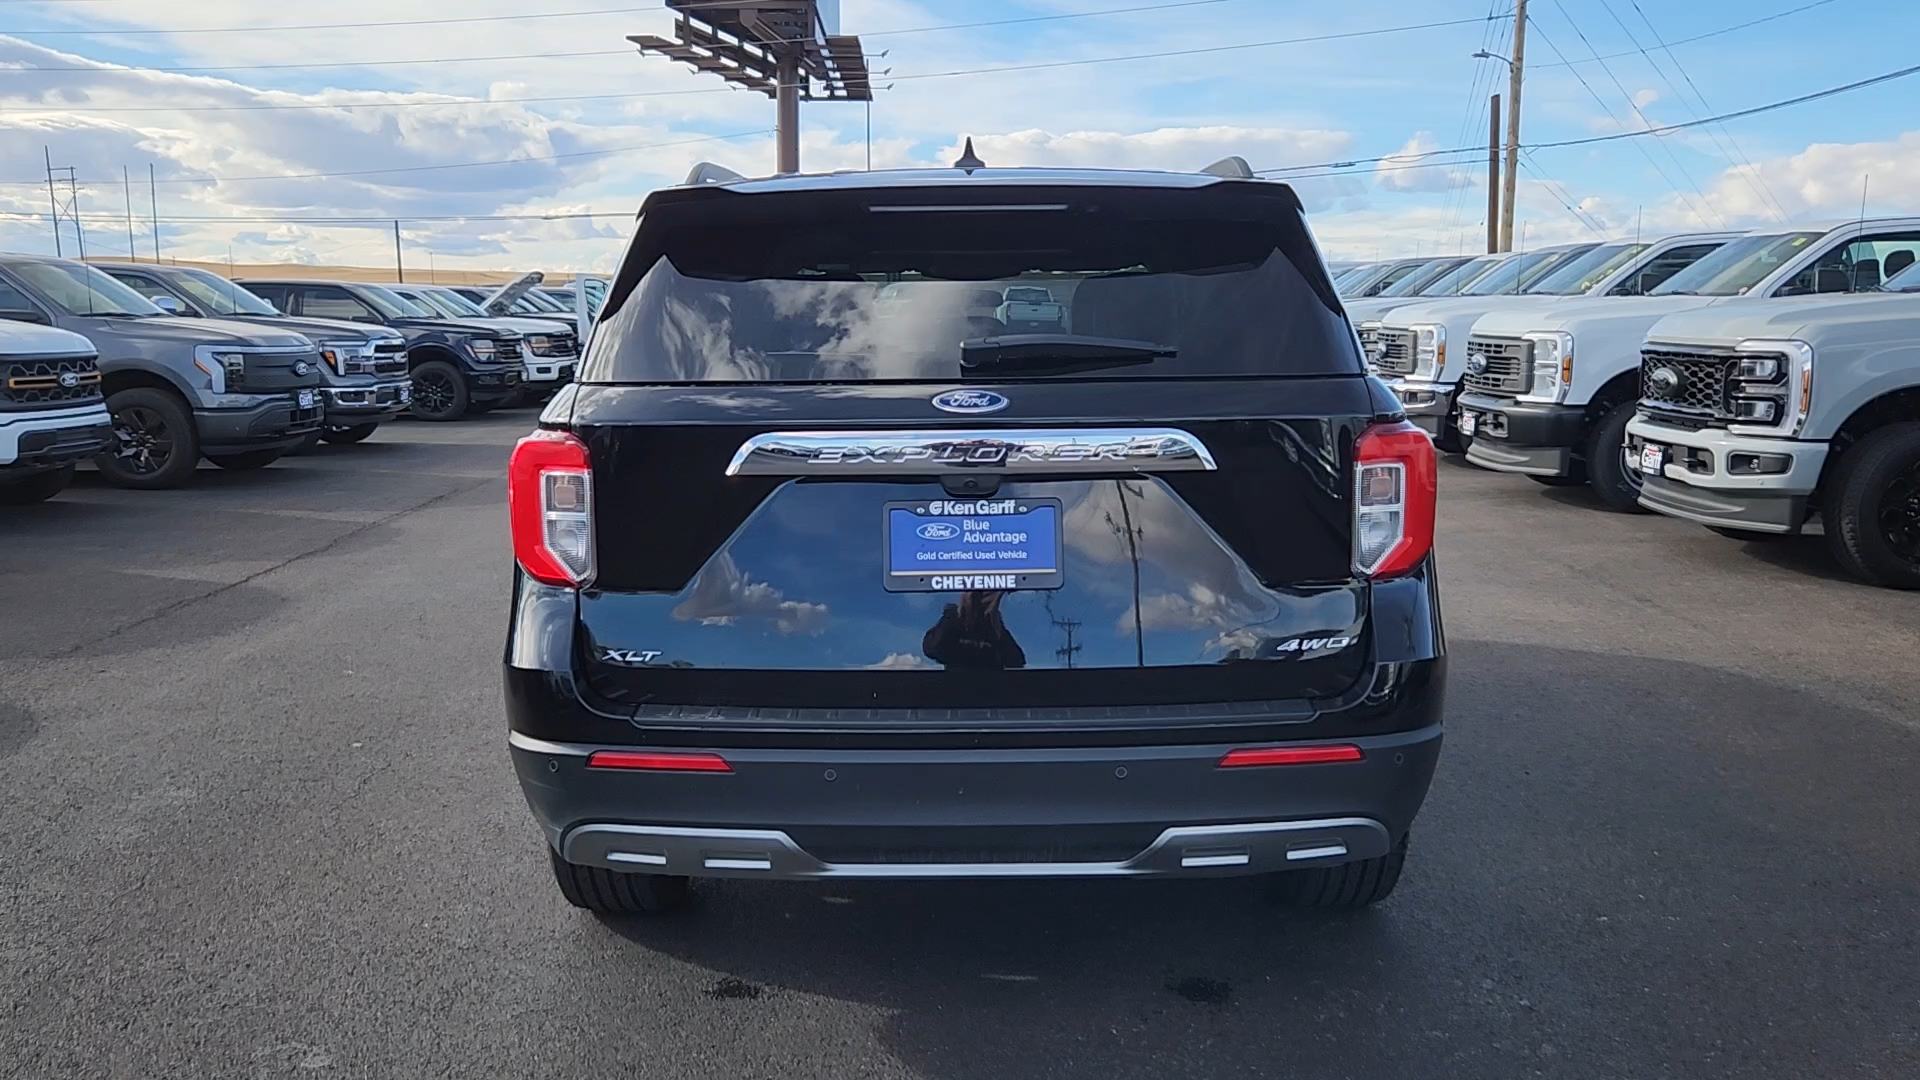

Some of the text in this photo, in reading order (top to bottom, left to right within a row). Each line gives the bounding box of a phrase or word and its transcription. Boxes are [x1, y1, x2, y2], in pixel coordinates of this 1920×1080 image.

[949, 392, 990, 407] Ford
[807, 445, 1128, 464] EXPLORER
[943, 500, 1016, 515] Ken Garff
[924, 524, 952, 538] Ford
[963, 519, 990, 531] Blue
[963, 531, 1028, 544] Advantage
[916, 550, 1028, 560] Gold Certified Used Vehicle
[931, 575, 1016, 590] CHEYENNE
[1277, 637, 1349, 651] 4WD
[602, 650, 661, 662] XLT
